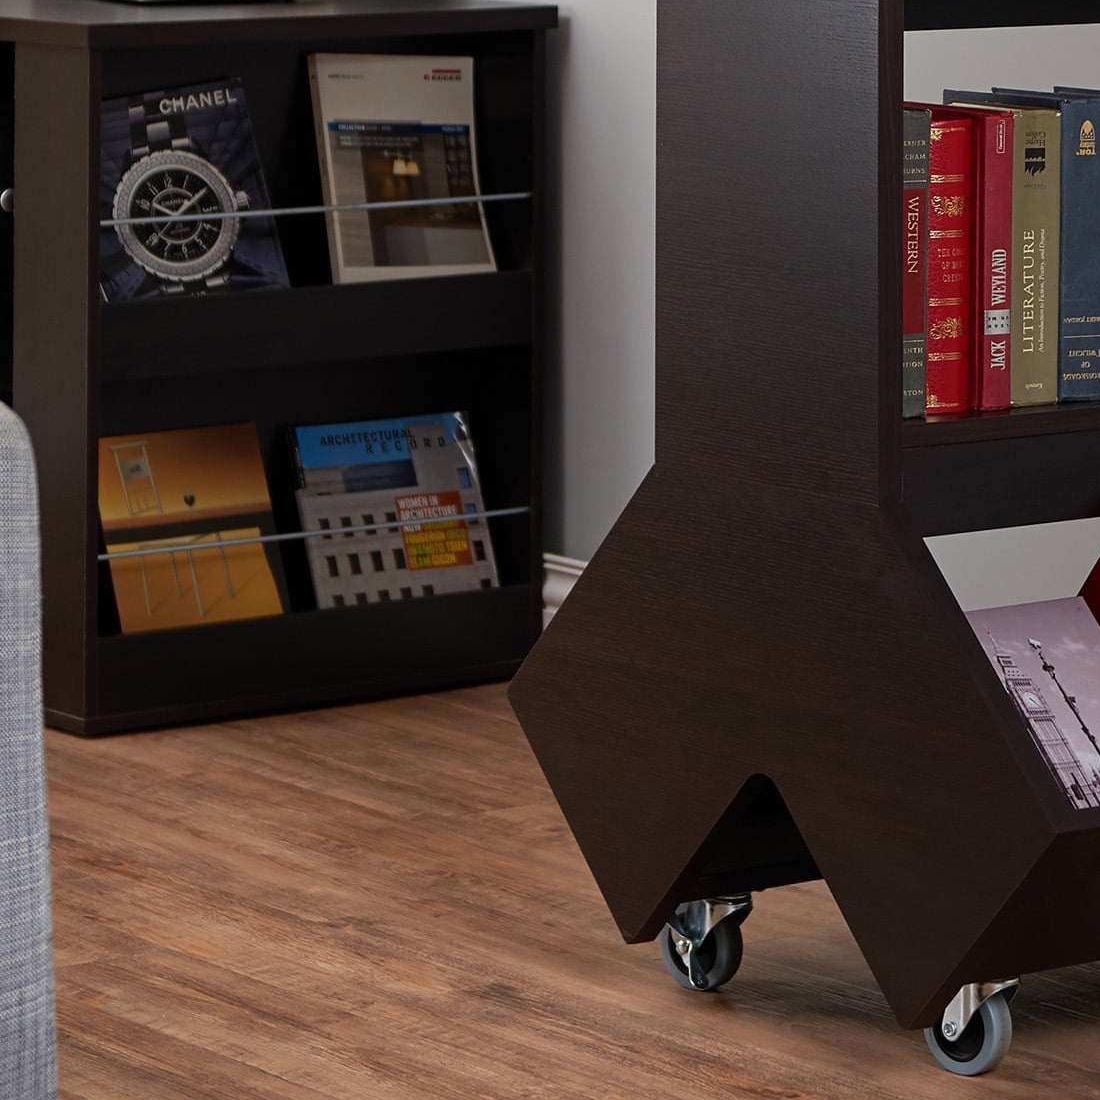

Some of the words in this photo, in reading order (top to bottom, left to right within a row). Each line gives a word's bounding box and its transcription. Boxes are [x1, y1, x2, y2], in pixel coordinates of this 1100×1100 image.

[159, 88, 238, 114] CHANEL
[1025, 140, 1046, 148] Harper
[907, 196, 920, 273] WESTERN
[991, 249, 1007, 306] WEYLAND
[1023, 229, 1035, 353] LITERATURE
[1038, 281, 1046, 302] Fiction,
[1038, 309, 1046, 344] Introduction
[1063, 316, 1086, 324] JORDAN
[990, 340, 1006, 371] JACK
[1038, 344, 1045, 353] An
[319, 428, 415, 447] ARCHITECTURAL
[365, 436, 446, 453] RECORD
[397, 496, 429, 509] WOMEN
[428, 494, 440, 506] IN
[400, 504, 457, 519] ARCHITECTURE
